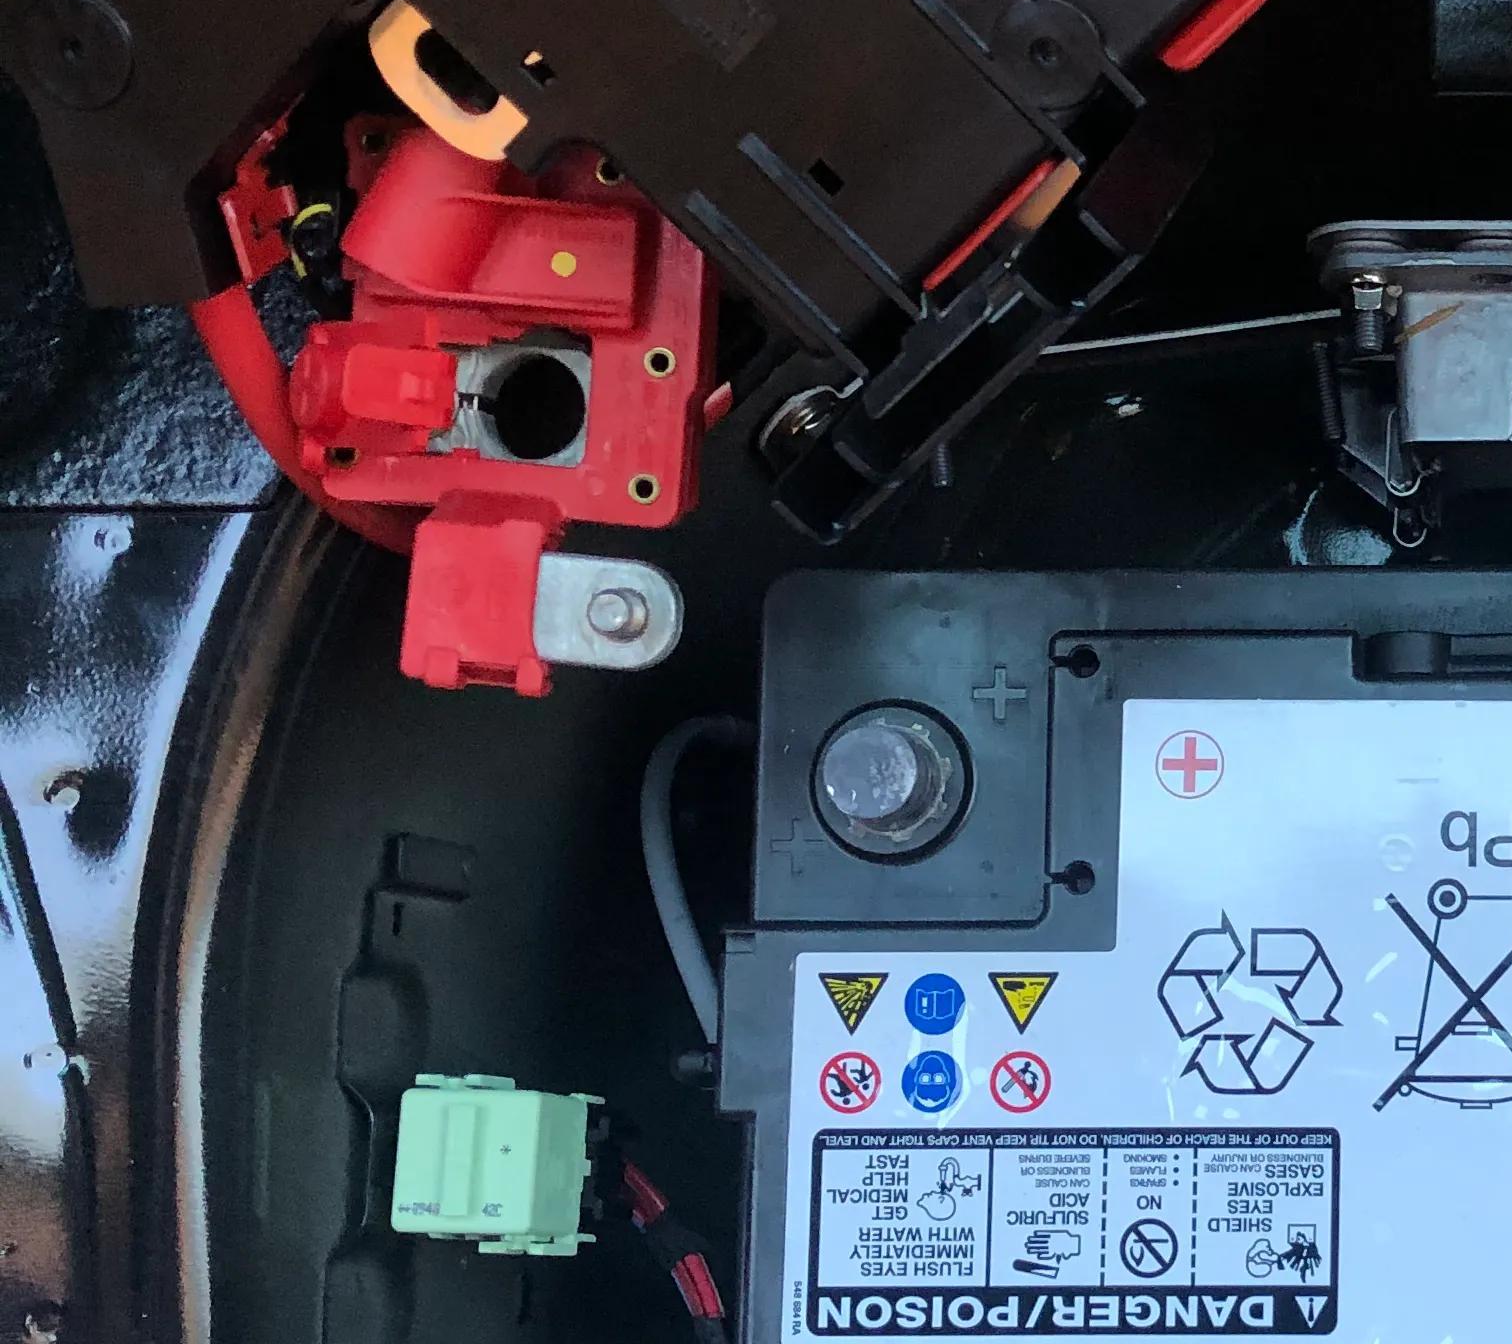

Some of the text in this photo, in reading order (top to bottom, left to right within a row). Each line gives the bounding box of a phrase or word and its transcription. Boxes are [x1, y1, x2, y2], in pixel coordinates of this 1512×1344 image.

[820, 1136, 858, 1145] LEVEL.
[861, 1136, 887, 1145] AND
[889, 1135, 924, 1145] TIGHT
[927, 1135, 959, 1145] CAPS
[962, 1135, 993, 1145] VENT
[995, 1135, 1026, 1145] KEEP
[1053, 1135, 1076, 1145] NOT
[1080, 1135, 1097, 1145] DO
[1101, 1134, 1163, 1145] CHILDREN.
[1166, 1134, 1182, 1144] OF
[1185, 1134, 1225, 1144] REACH
[1229, 1134, 1252, 1144] THE
[1255, 1134, 1271, 1144] OF
[1273, 1134, 1298, 1144] OUT
[1301, 1135, 1331, 1144] KEEP
[865, 1155, 909, 1169] FAST
[1018, 1153, 1090, 1164] SEVERE BURNS
[1124, 1154, 1167, 1162] SMOKING
[1211, 1154, 1323, 1162] BLINDNESS OR INJURY
[1020, 1166, 1091, 1176] BLINDNESS OR
[1130, 1166, 1166, 1175] FLAMES
[1204, 1164, 1324, 1178] GASES CAN CAUSE
[862, 1172, 908, 1186] HELP
[1034, 1178, 1090, 1188] CAN CAUSE
[1130, 1178, 1166, 1187] SPARKS
[1228, 1182, 1323, 1196] EXPLOSIVE
[827, 1189, 908, 1203] MEDICAL
[1050, 1193, 1089, 1207] ACID
[1137, 1196, 1161, 1209] NO
[1228, 1200, 1272, 1214] EYES
[872, 1206, 907, 1220] GET
[1007, 1211, 1088, 1225] SULFURIC
[1208, 1218, 1272, 1232] SHIELD
[859, 1227, 974, 1241] WITH WATER
[850, 1245, 973, 1259] IMMEDIATELY
[861, 1262, 973, 1276] FLUSH EYES
[818, 1296, 1273, 1328] DANGER/POISON
